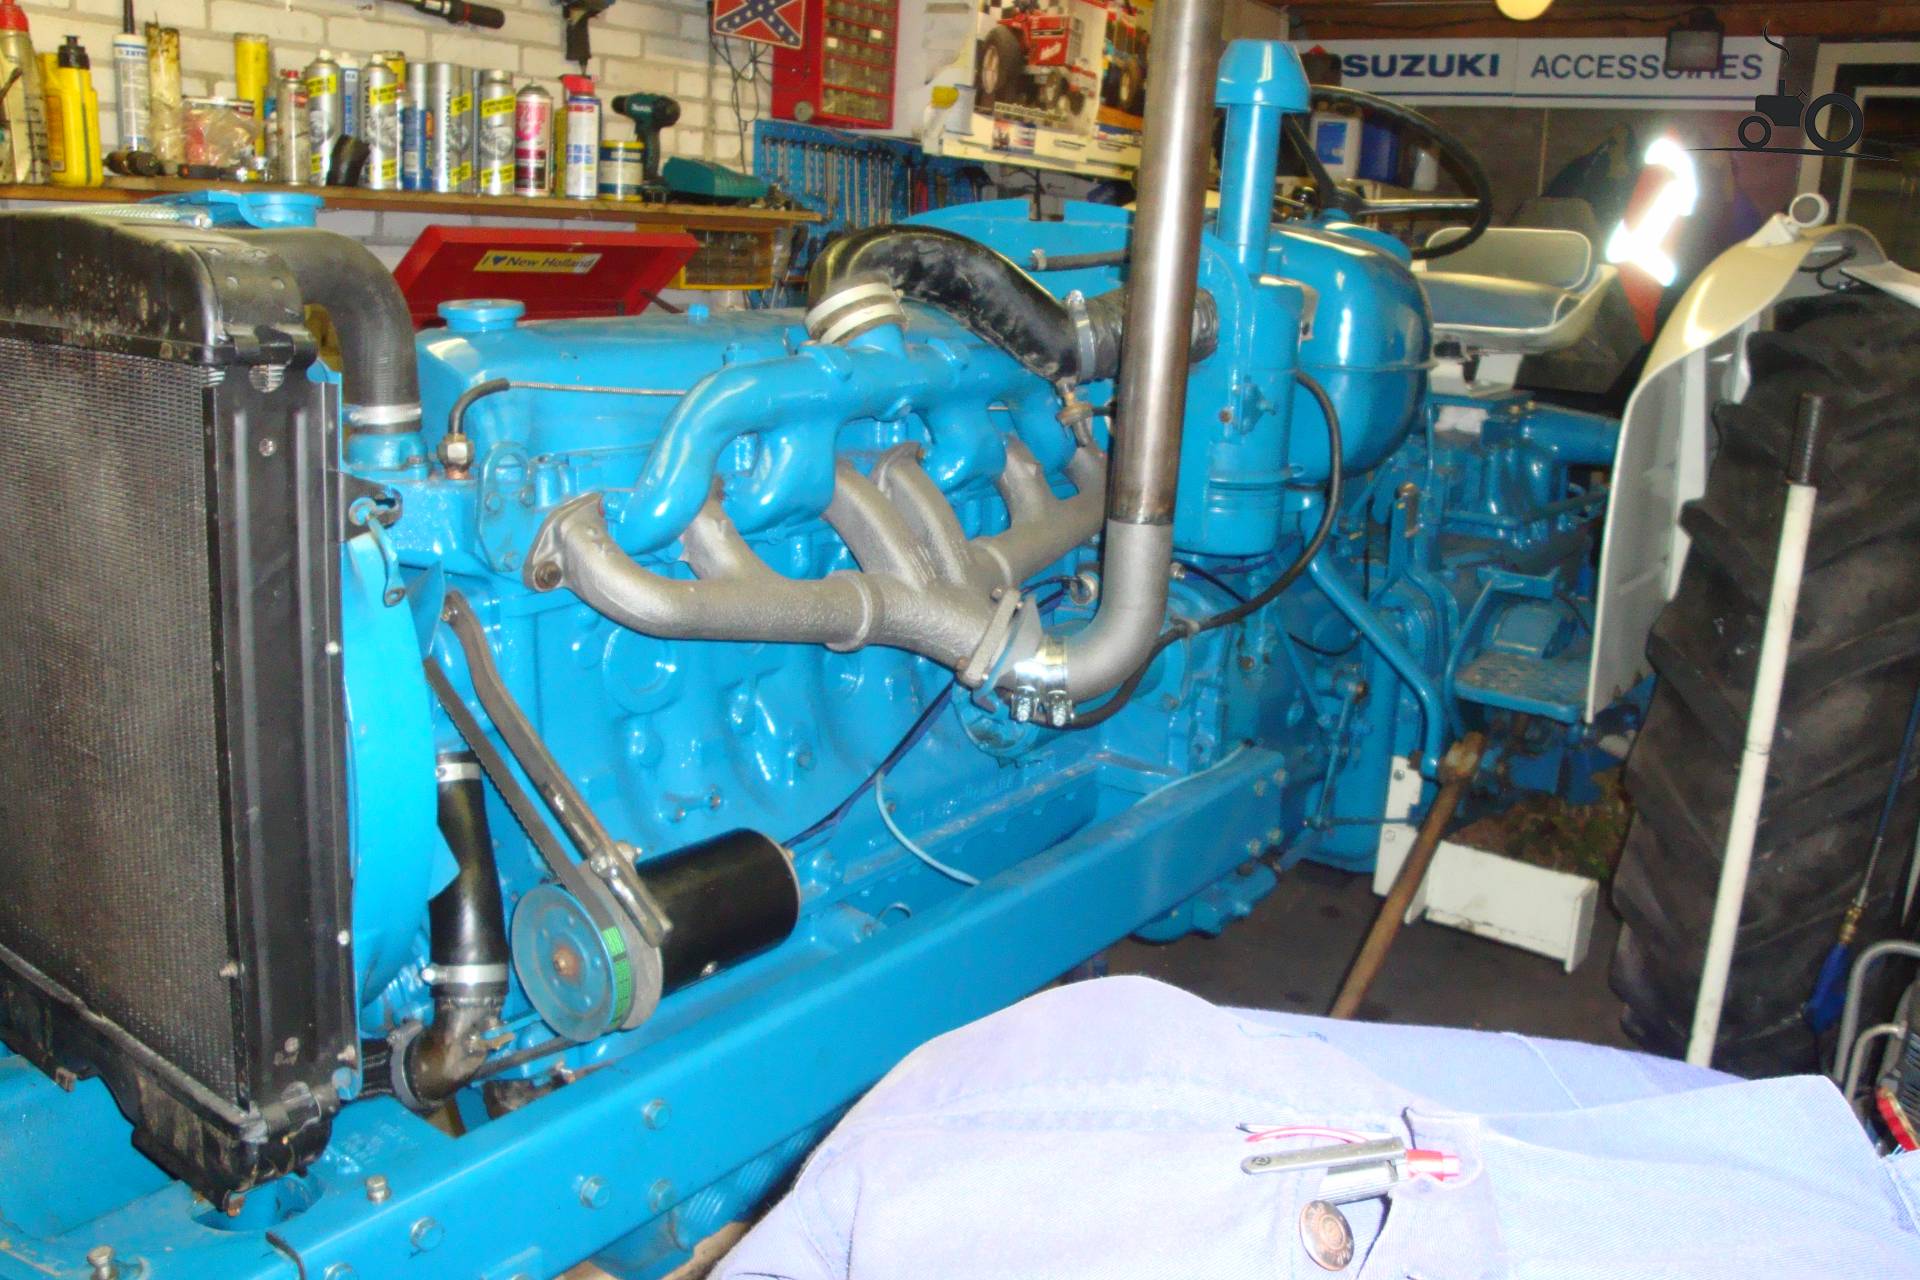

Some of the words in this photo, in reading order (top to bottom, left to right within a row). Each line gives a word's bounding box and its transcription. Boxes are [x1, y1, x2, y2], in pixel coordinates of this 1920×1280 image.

[1342, 53, 1500, 78] SUZUKI
[507, 256, 538, 267] New
[542, 256, 595, 267] Holland
